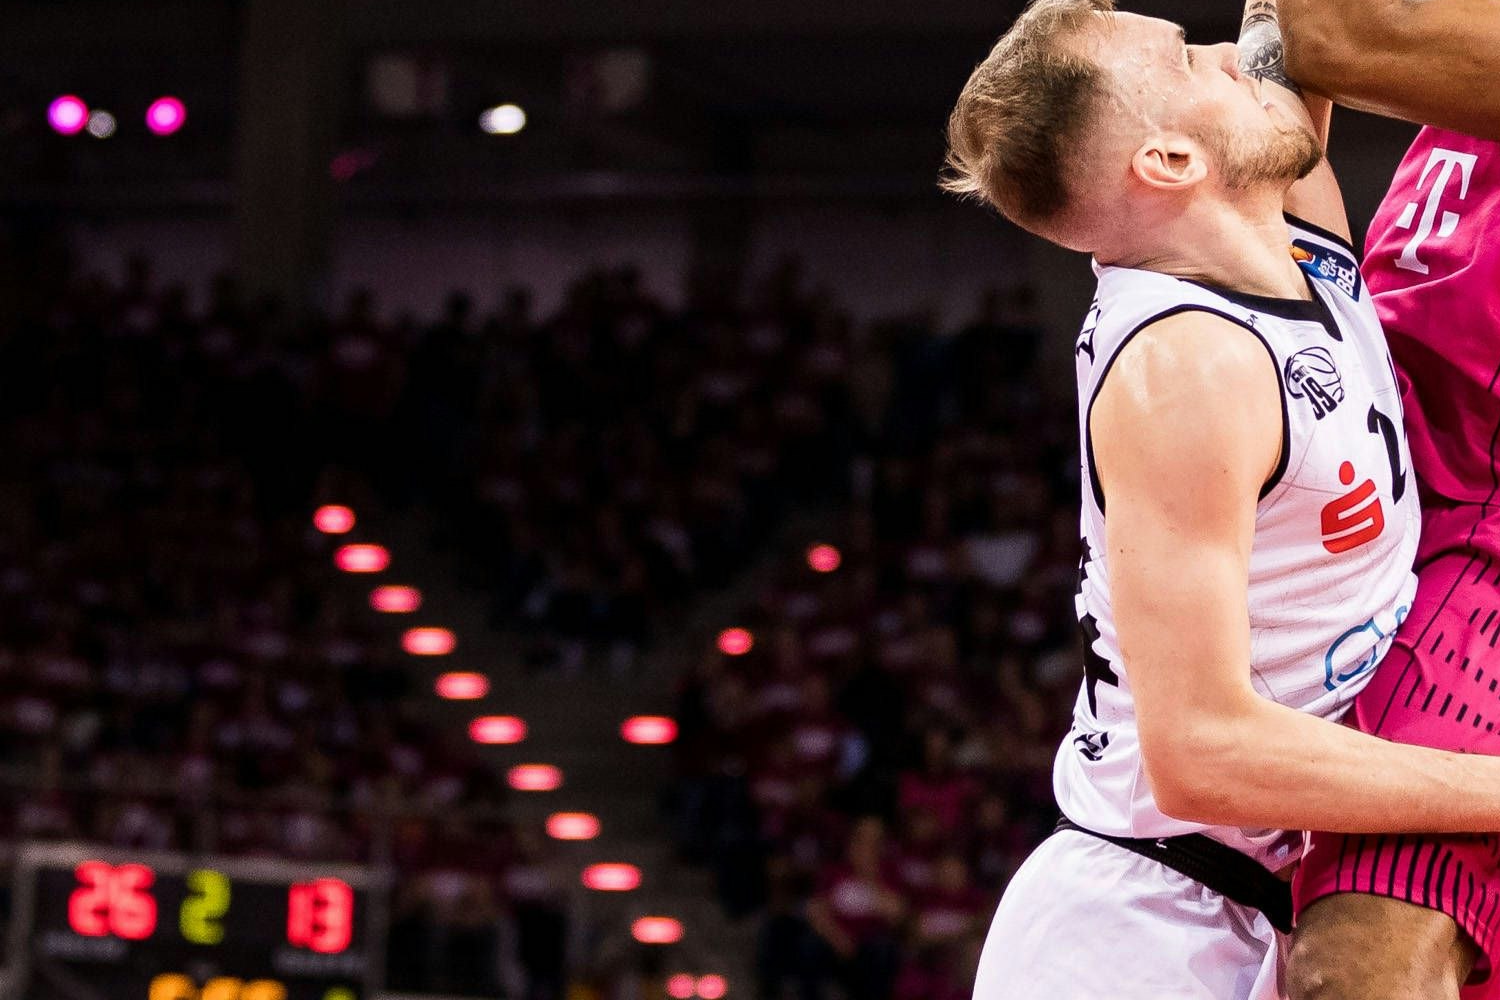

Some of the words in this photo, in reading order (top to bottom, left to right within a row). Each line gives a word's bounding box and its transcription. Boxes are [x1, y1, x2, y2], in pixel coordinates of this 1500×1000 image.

[1395, 147, 1479, 275] T
[68, 861, 157, 940] 26
[179, 870, 231, 945] 2
